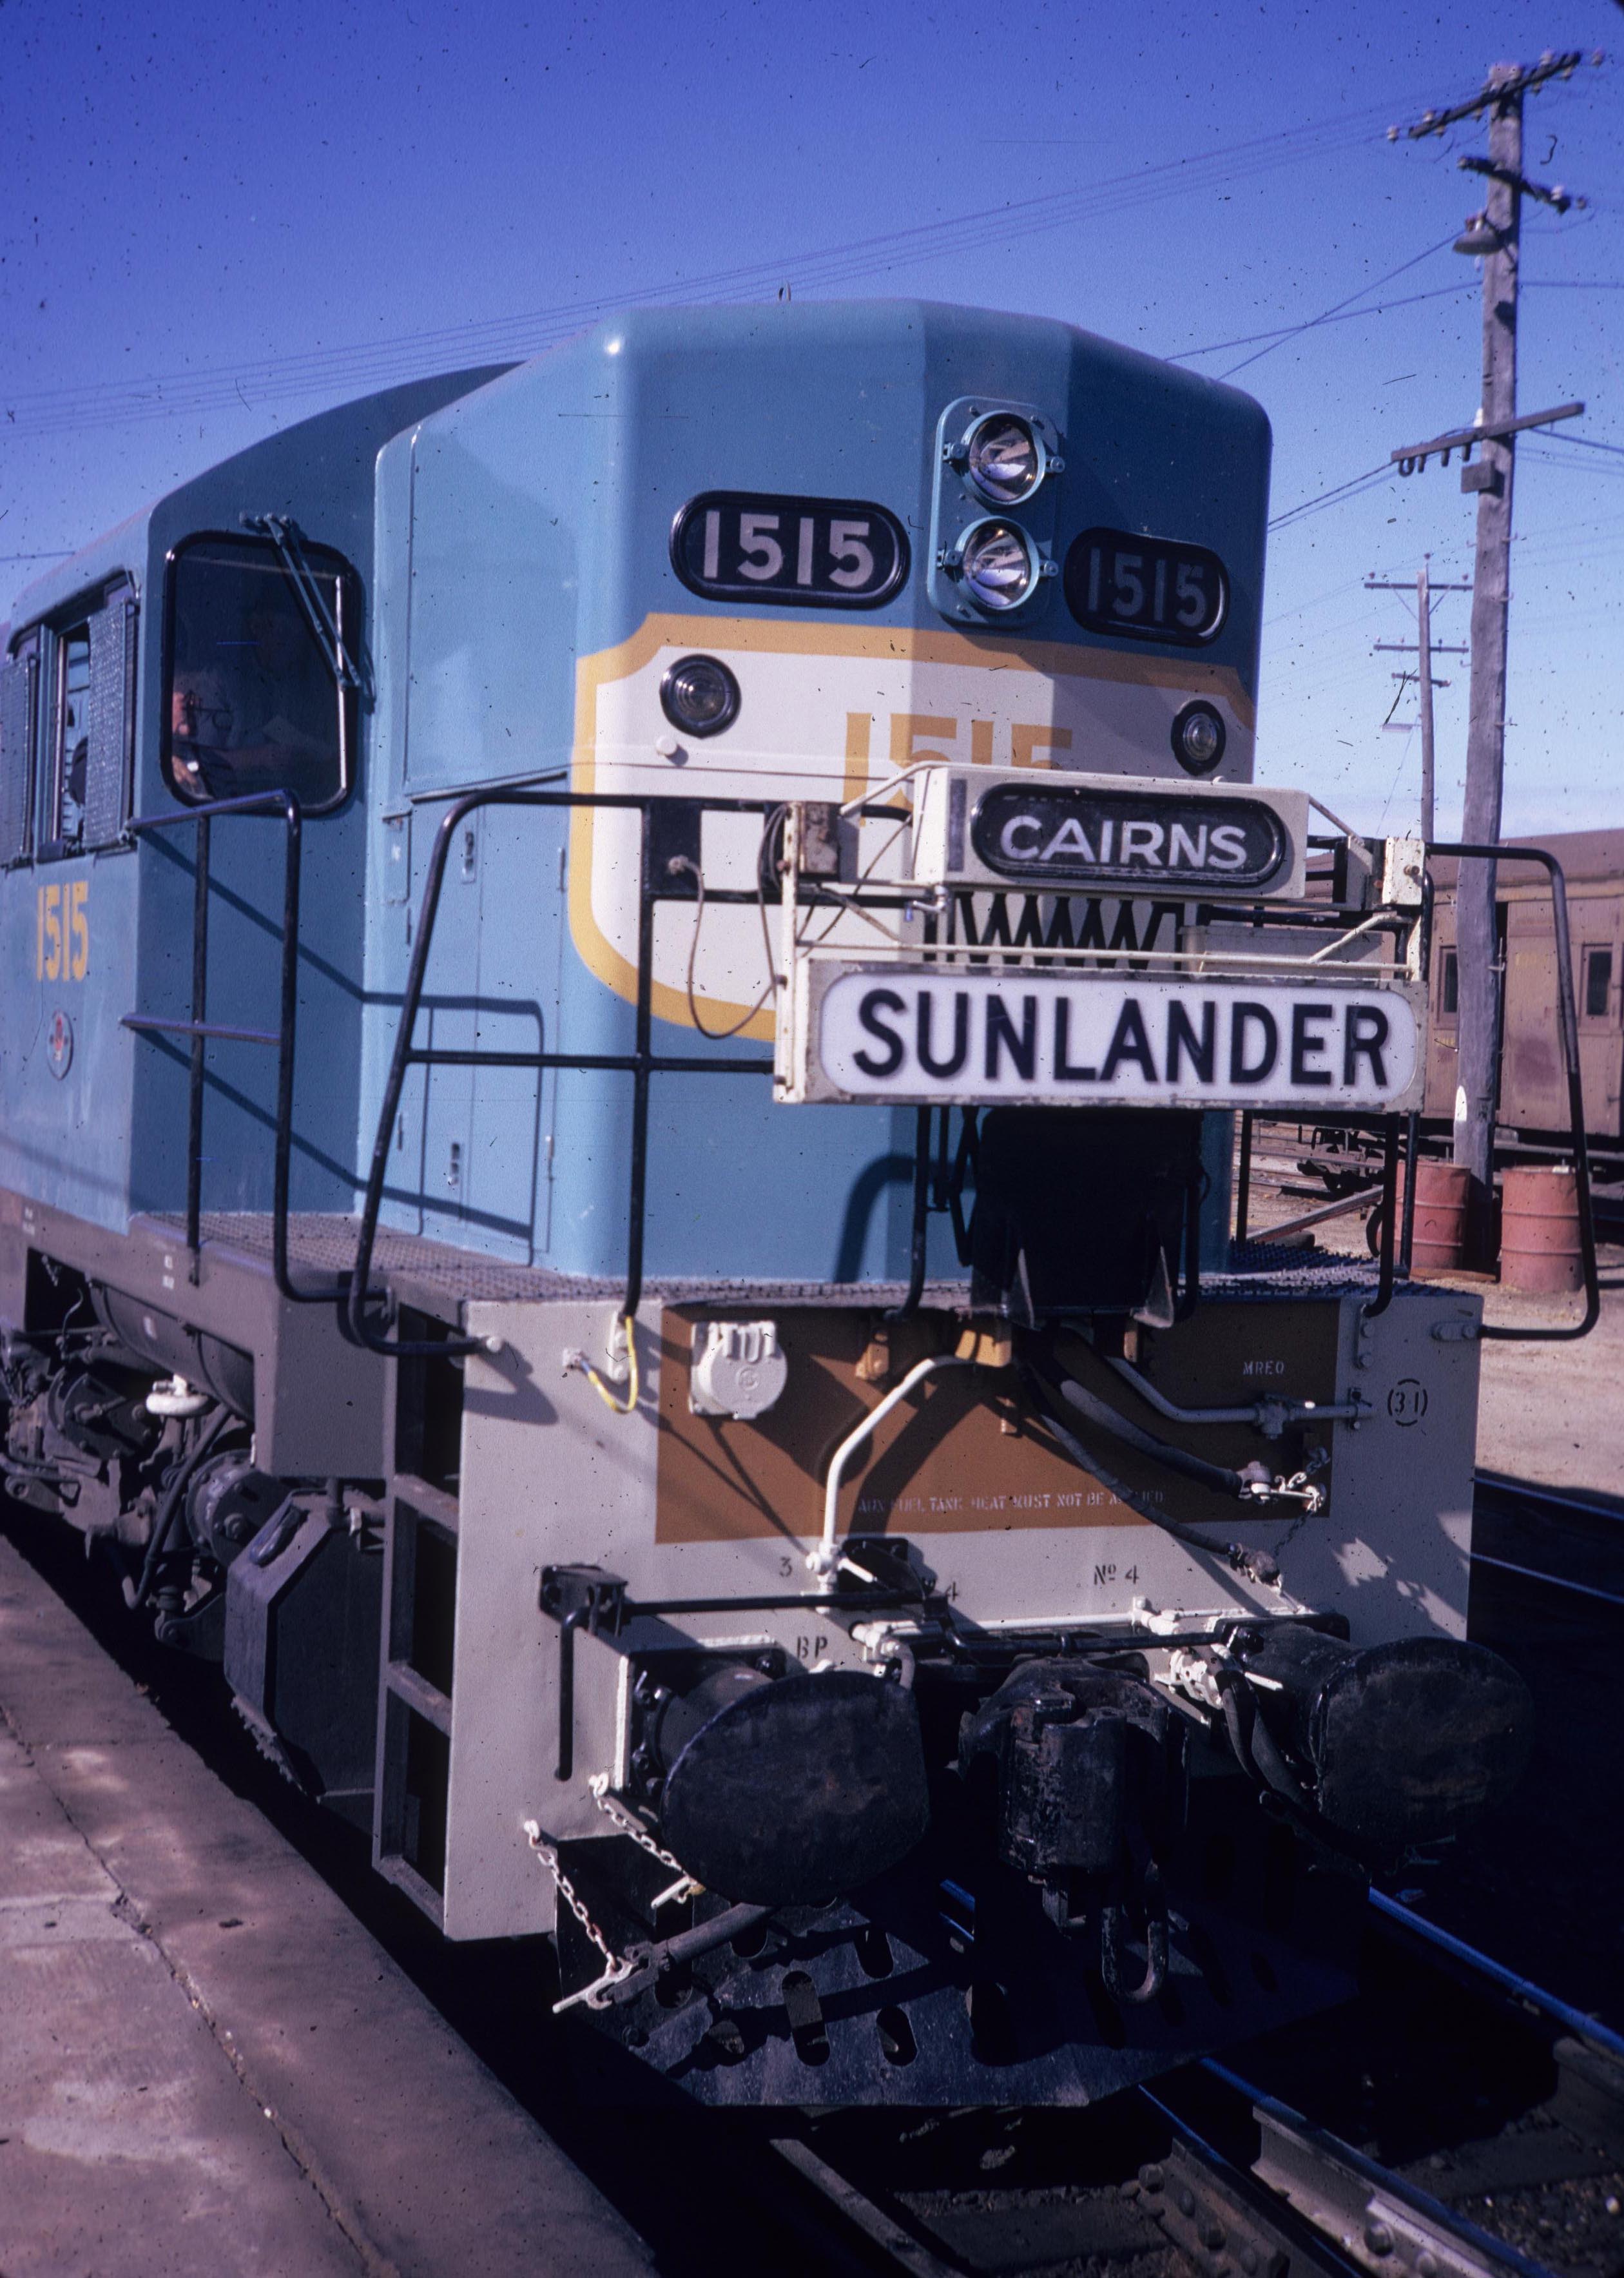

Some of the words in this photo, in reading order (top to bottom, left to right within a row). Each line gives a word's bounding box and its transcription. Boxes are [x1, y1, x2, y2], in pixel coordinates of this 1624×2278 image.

[703, 510, 875, 589] 1515
[1088, 547, 1206, 627] 1515
[1000, 815, 1247, 870] CAIRNS
[37, 881, 89, 982] 1515
[853, 989, 1389, 1086] SUNLANDER
[929, 1497, 963, 1511] TANK
[1012, 1494, 1050, 1509] MUST
[1057, 1493, 1083, 1507] NOT
[1087, 1492, 1105, 1506] BE
[1109, 1490, 1164, 1505] AIED
[778, 1556, 793, 1577] 3
[1125, 1564, 1140, 1585] 4
[797, 1635, 828, 1659] BP
